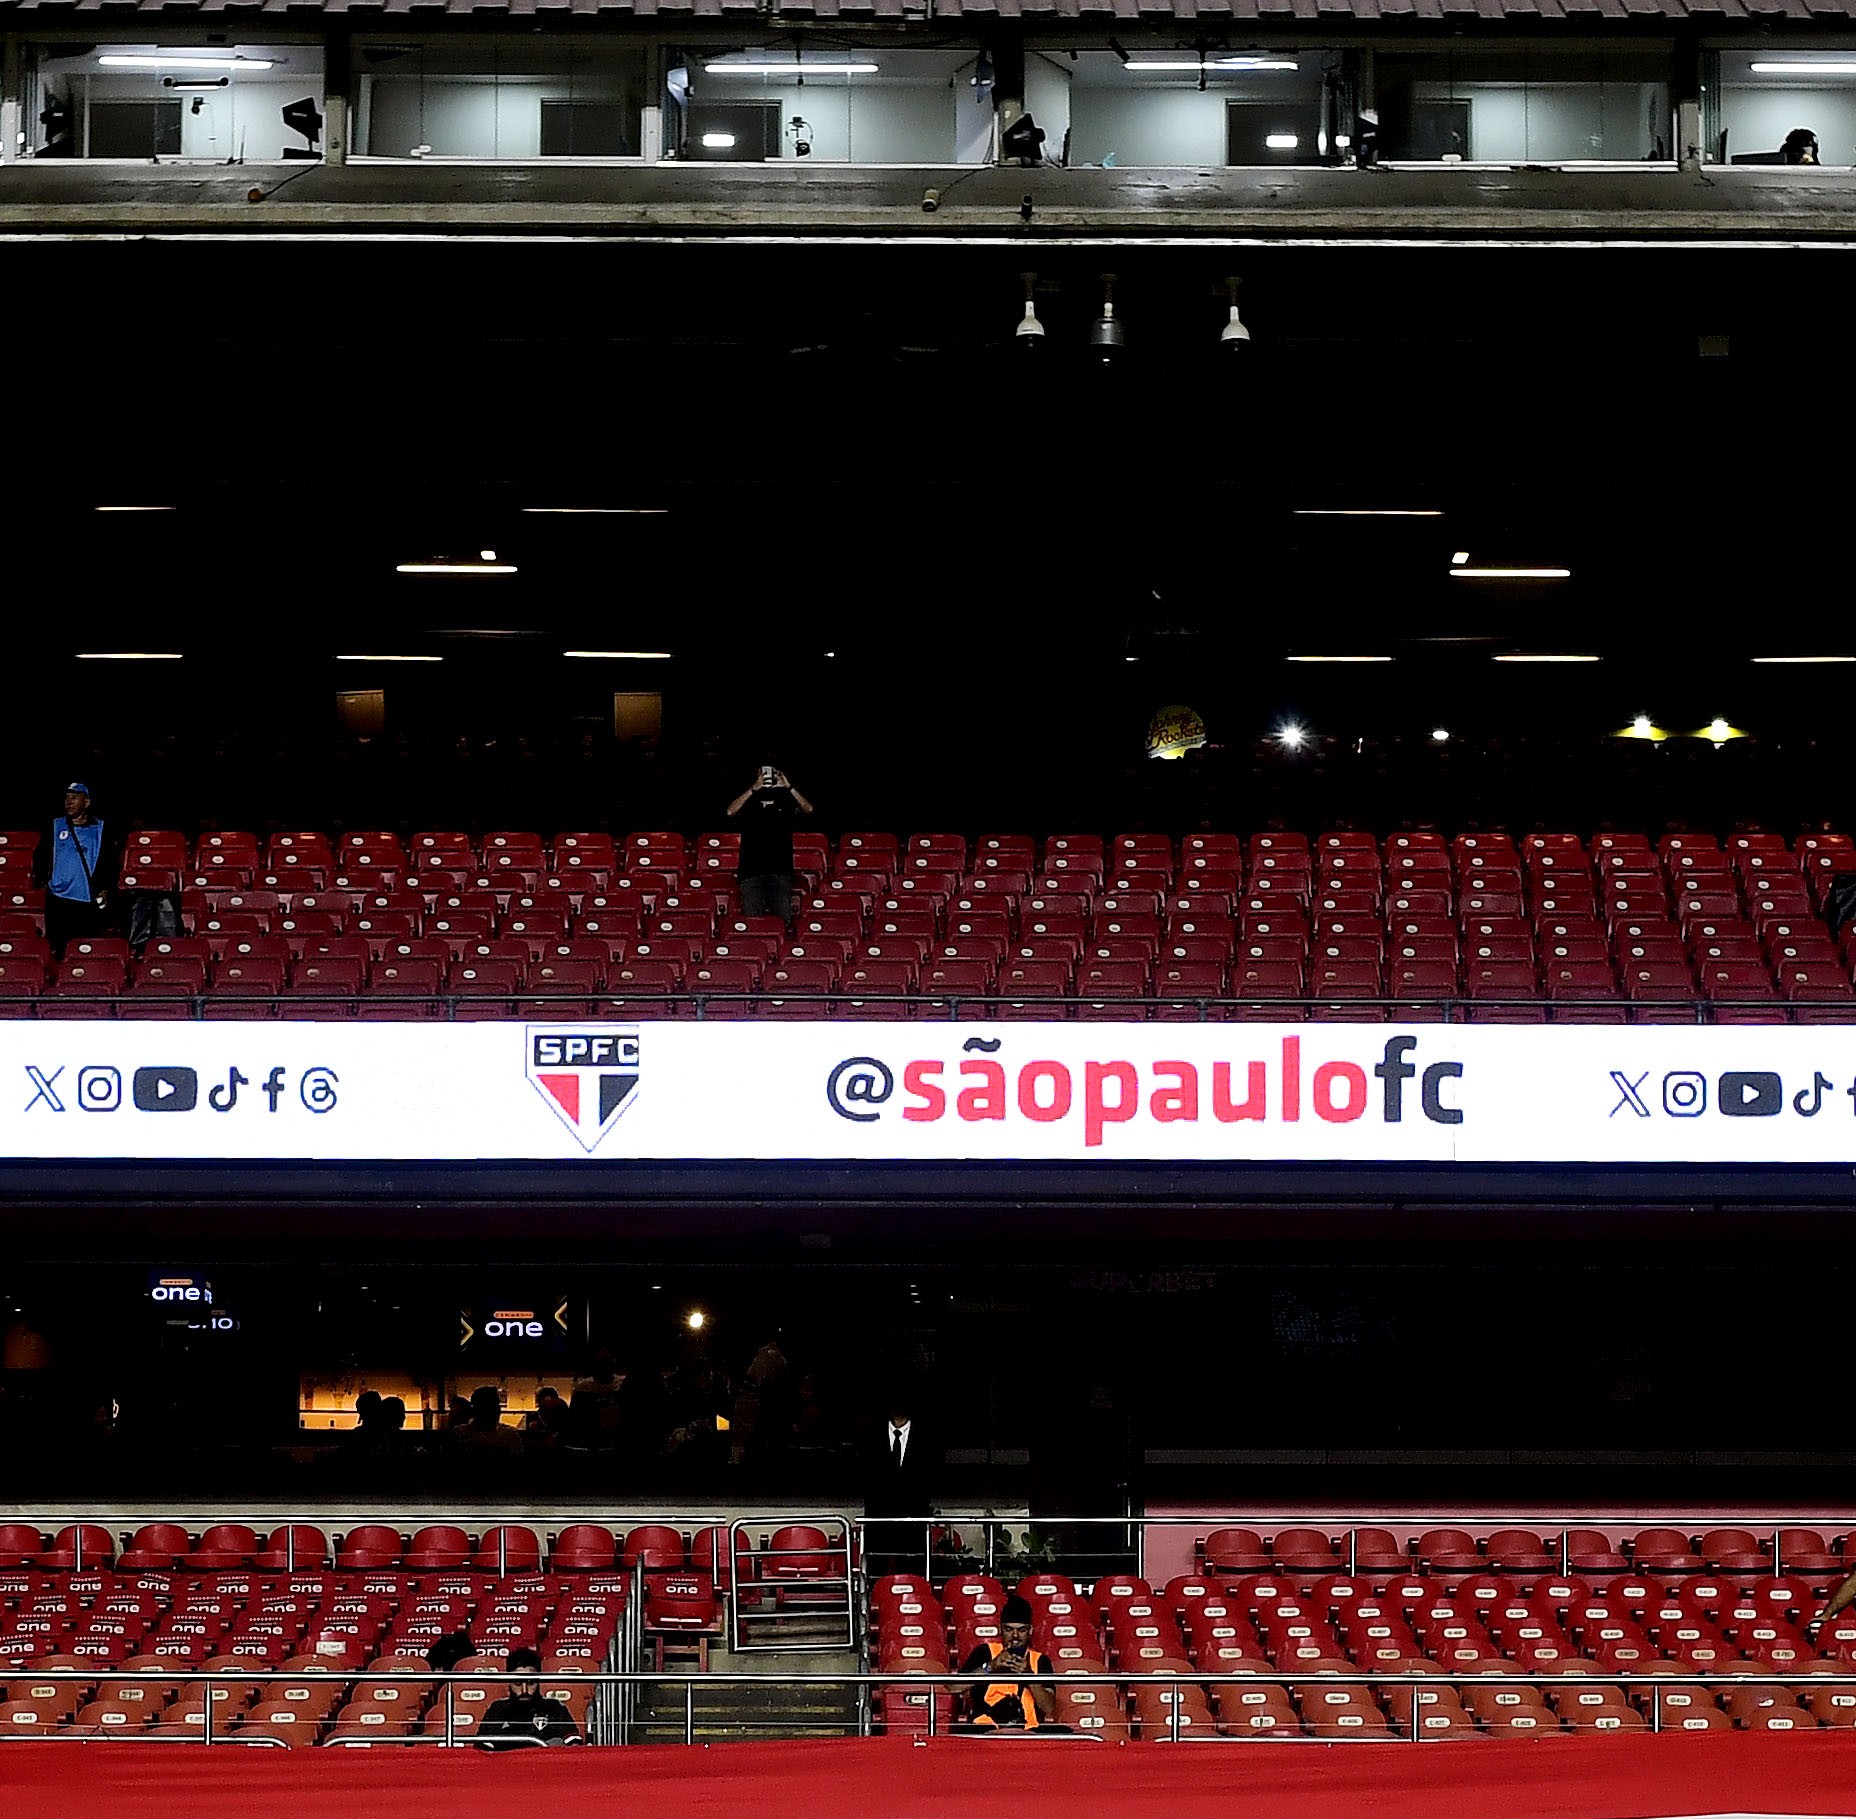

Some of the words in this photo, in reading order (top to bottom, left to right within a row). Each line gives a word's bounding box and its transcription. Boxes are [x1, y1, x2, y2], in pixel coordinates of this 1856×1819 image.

[539, 1037, 639, 1065] SPFC
[827, 1035, 1464, 1147] @sãopaulofc
[152, 1286, 201, 1301] one
[485, 1321, 544, 1337] one
